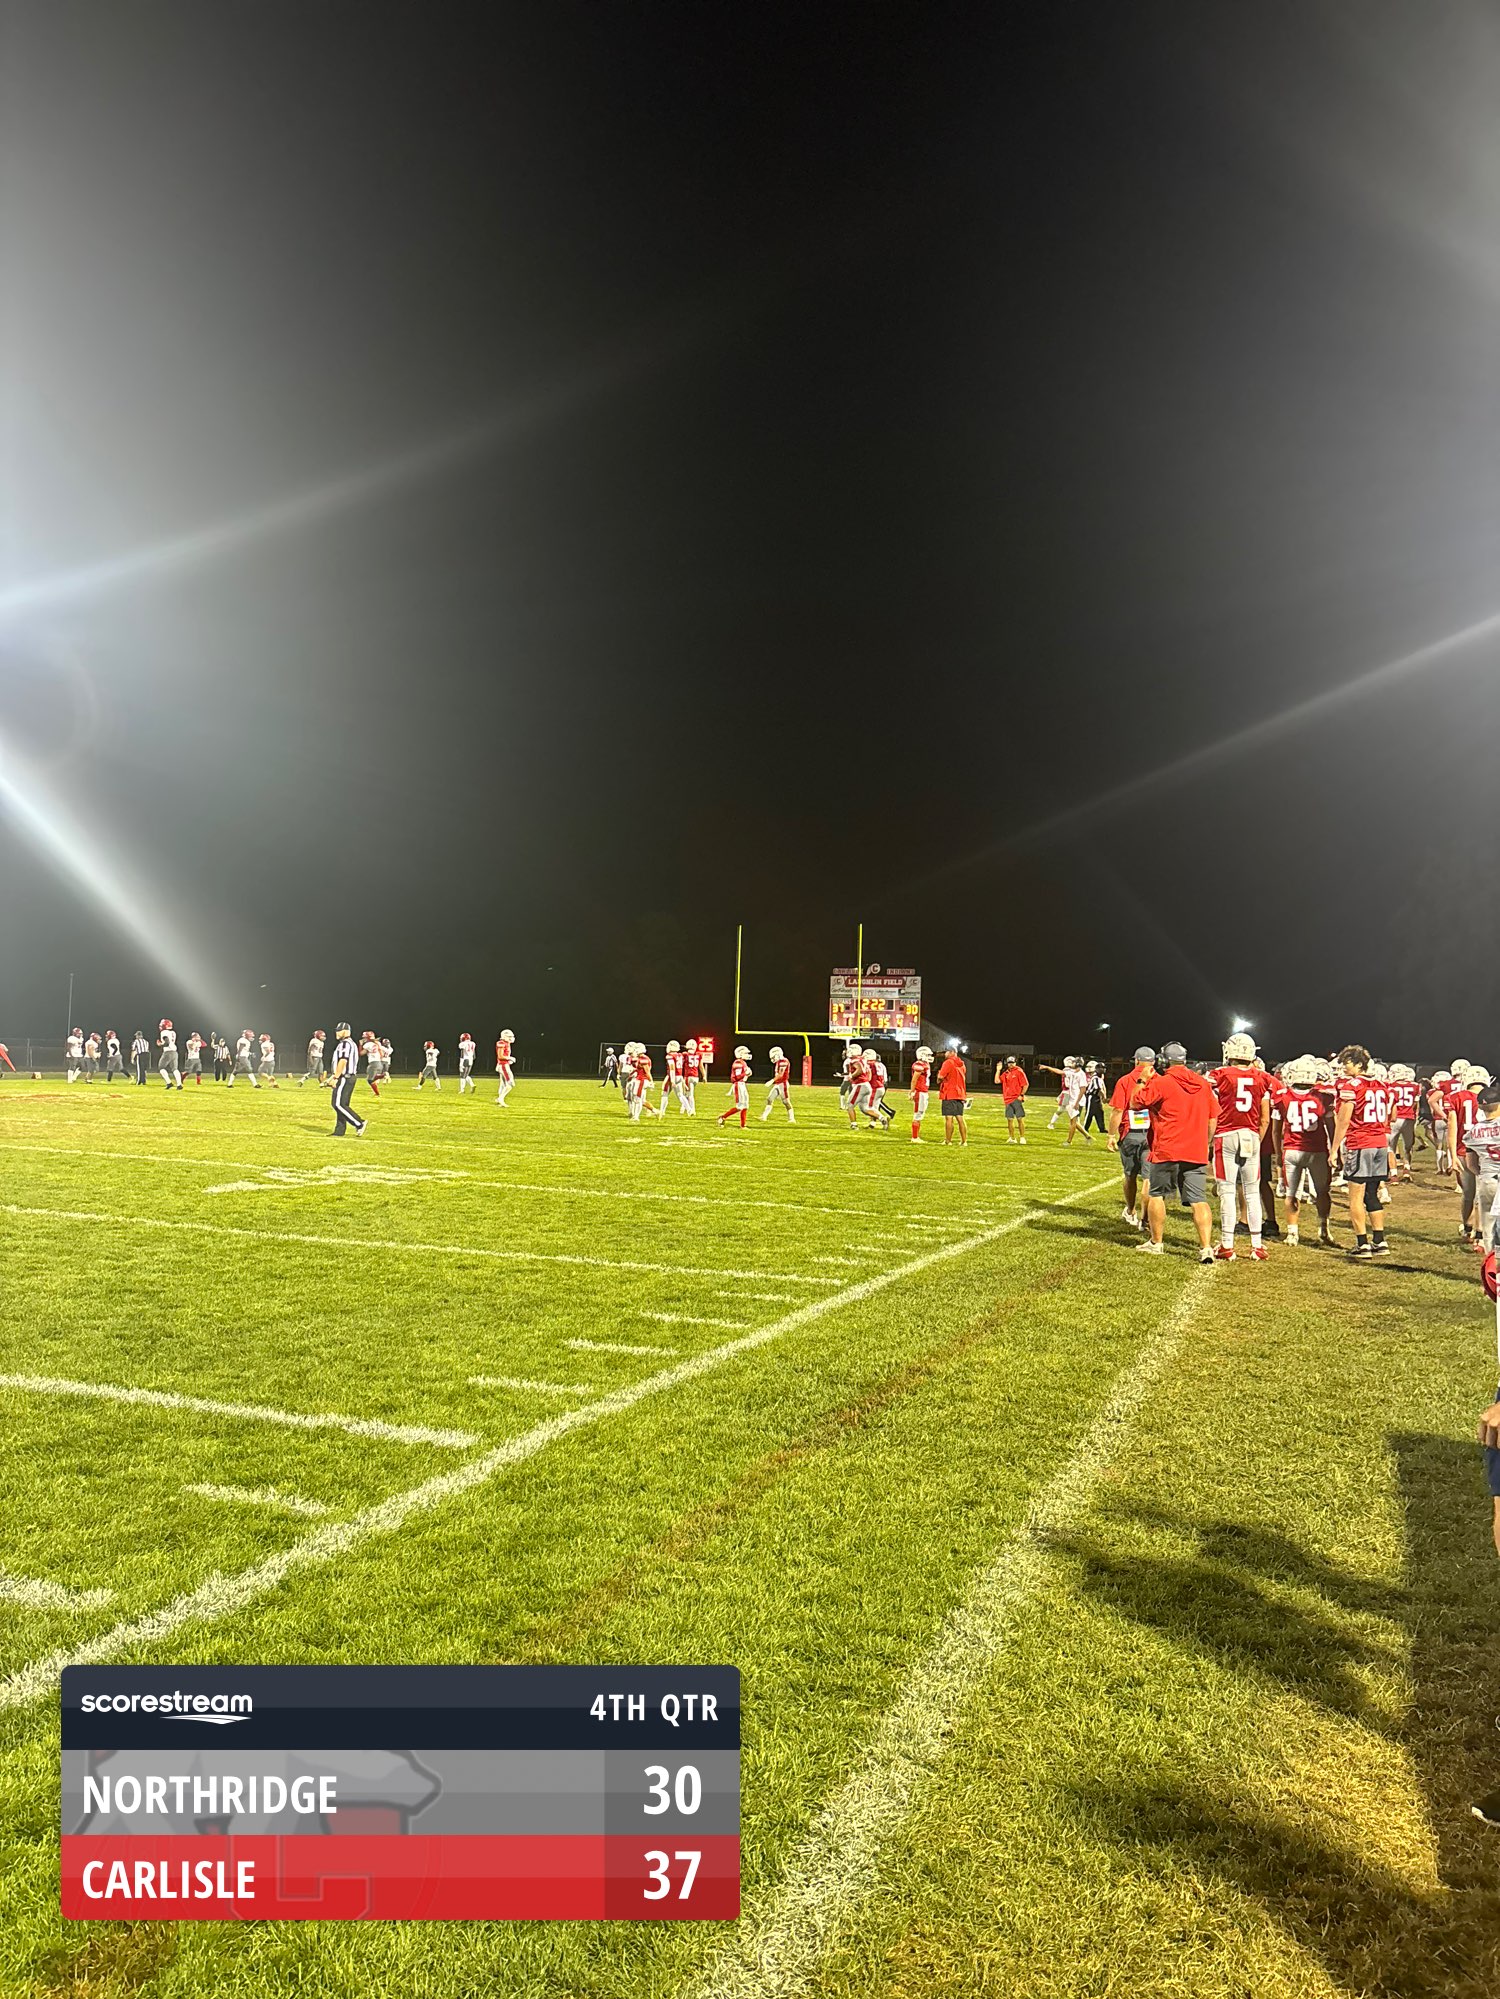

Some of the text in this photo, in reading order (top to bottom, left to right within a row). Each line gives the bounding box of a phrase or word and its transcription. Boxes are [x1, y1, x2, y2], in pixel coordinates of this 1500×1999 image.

[906, 1004, 918, 1015] 30
[699, 1037, 713, 1051] 25
[1235, 1077, 1253, 1112] 5
[1363, 1089, 1387, 1123] 26
[1286, 1100, 1318, 1132] 46
